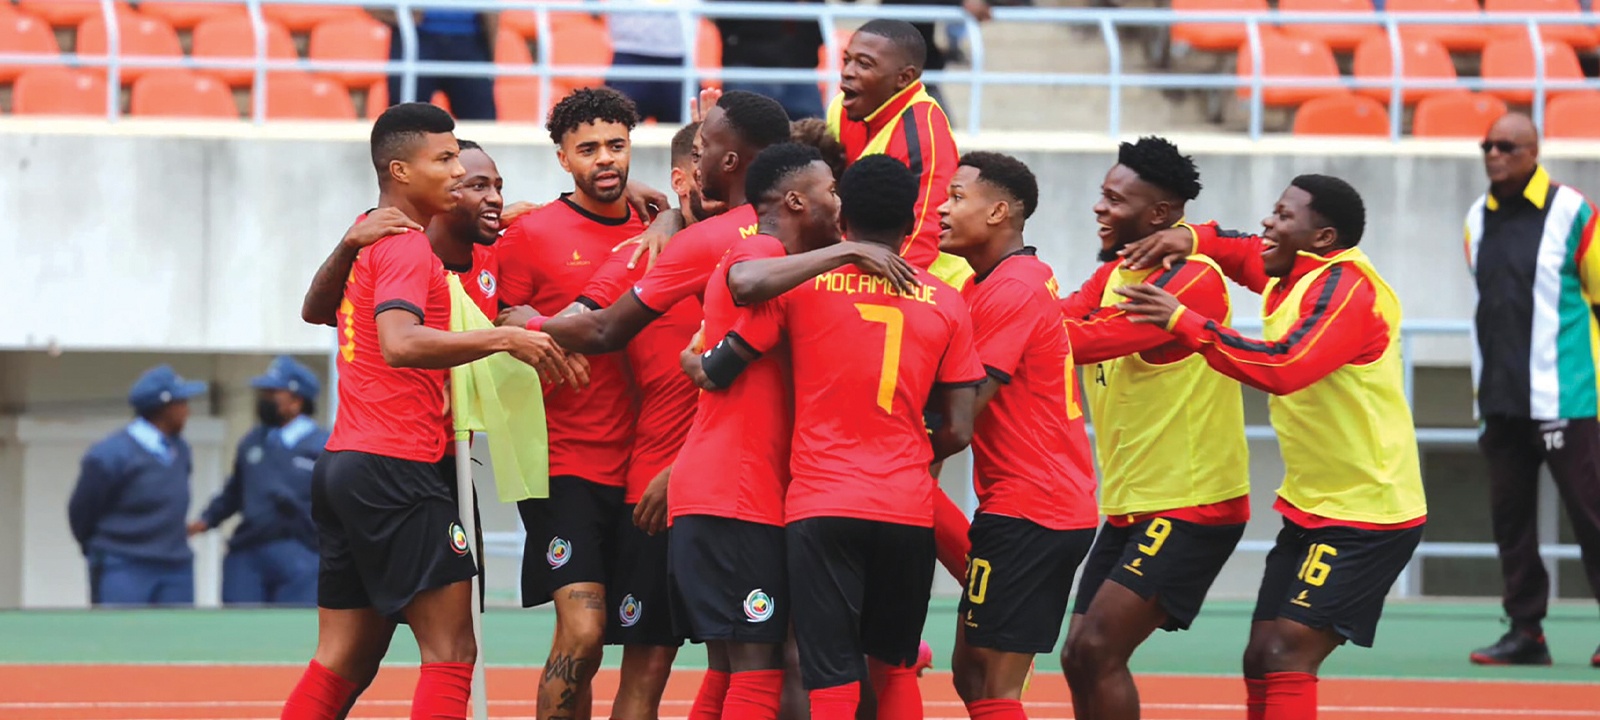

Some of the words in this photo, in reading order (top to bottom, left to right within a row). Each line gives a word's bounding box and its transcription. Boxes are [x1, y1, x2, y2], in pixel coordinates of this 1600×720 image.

[854, 303, 904, 415] 7
[1137, 516, 1172, 557] 9
[1297, 542, 1338, 587] 16
